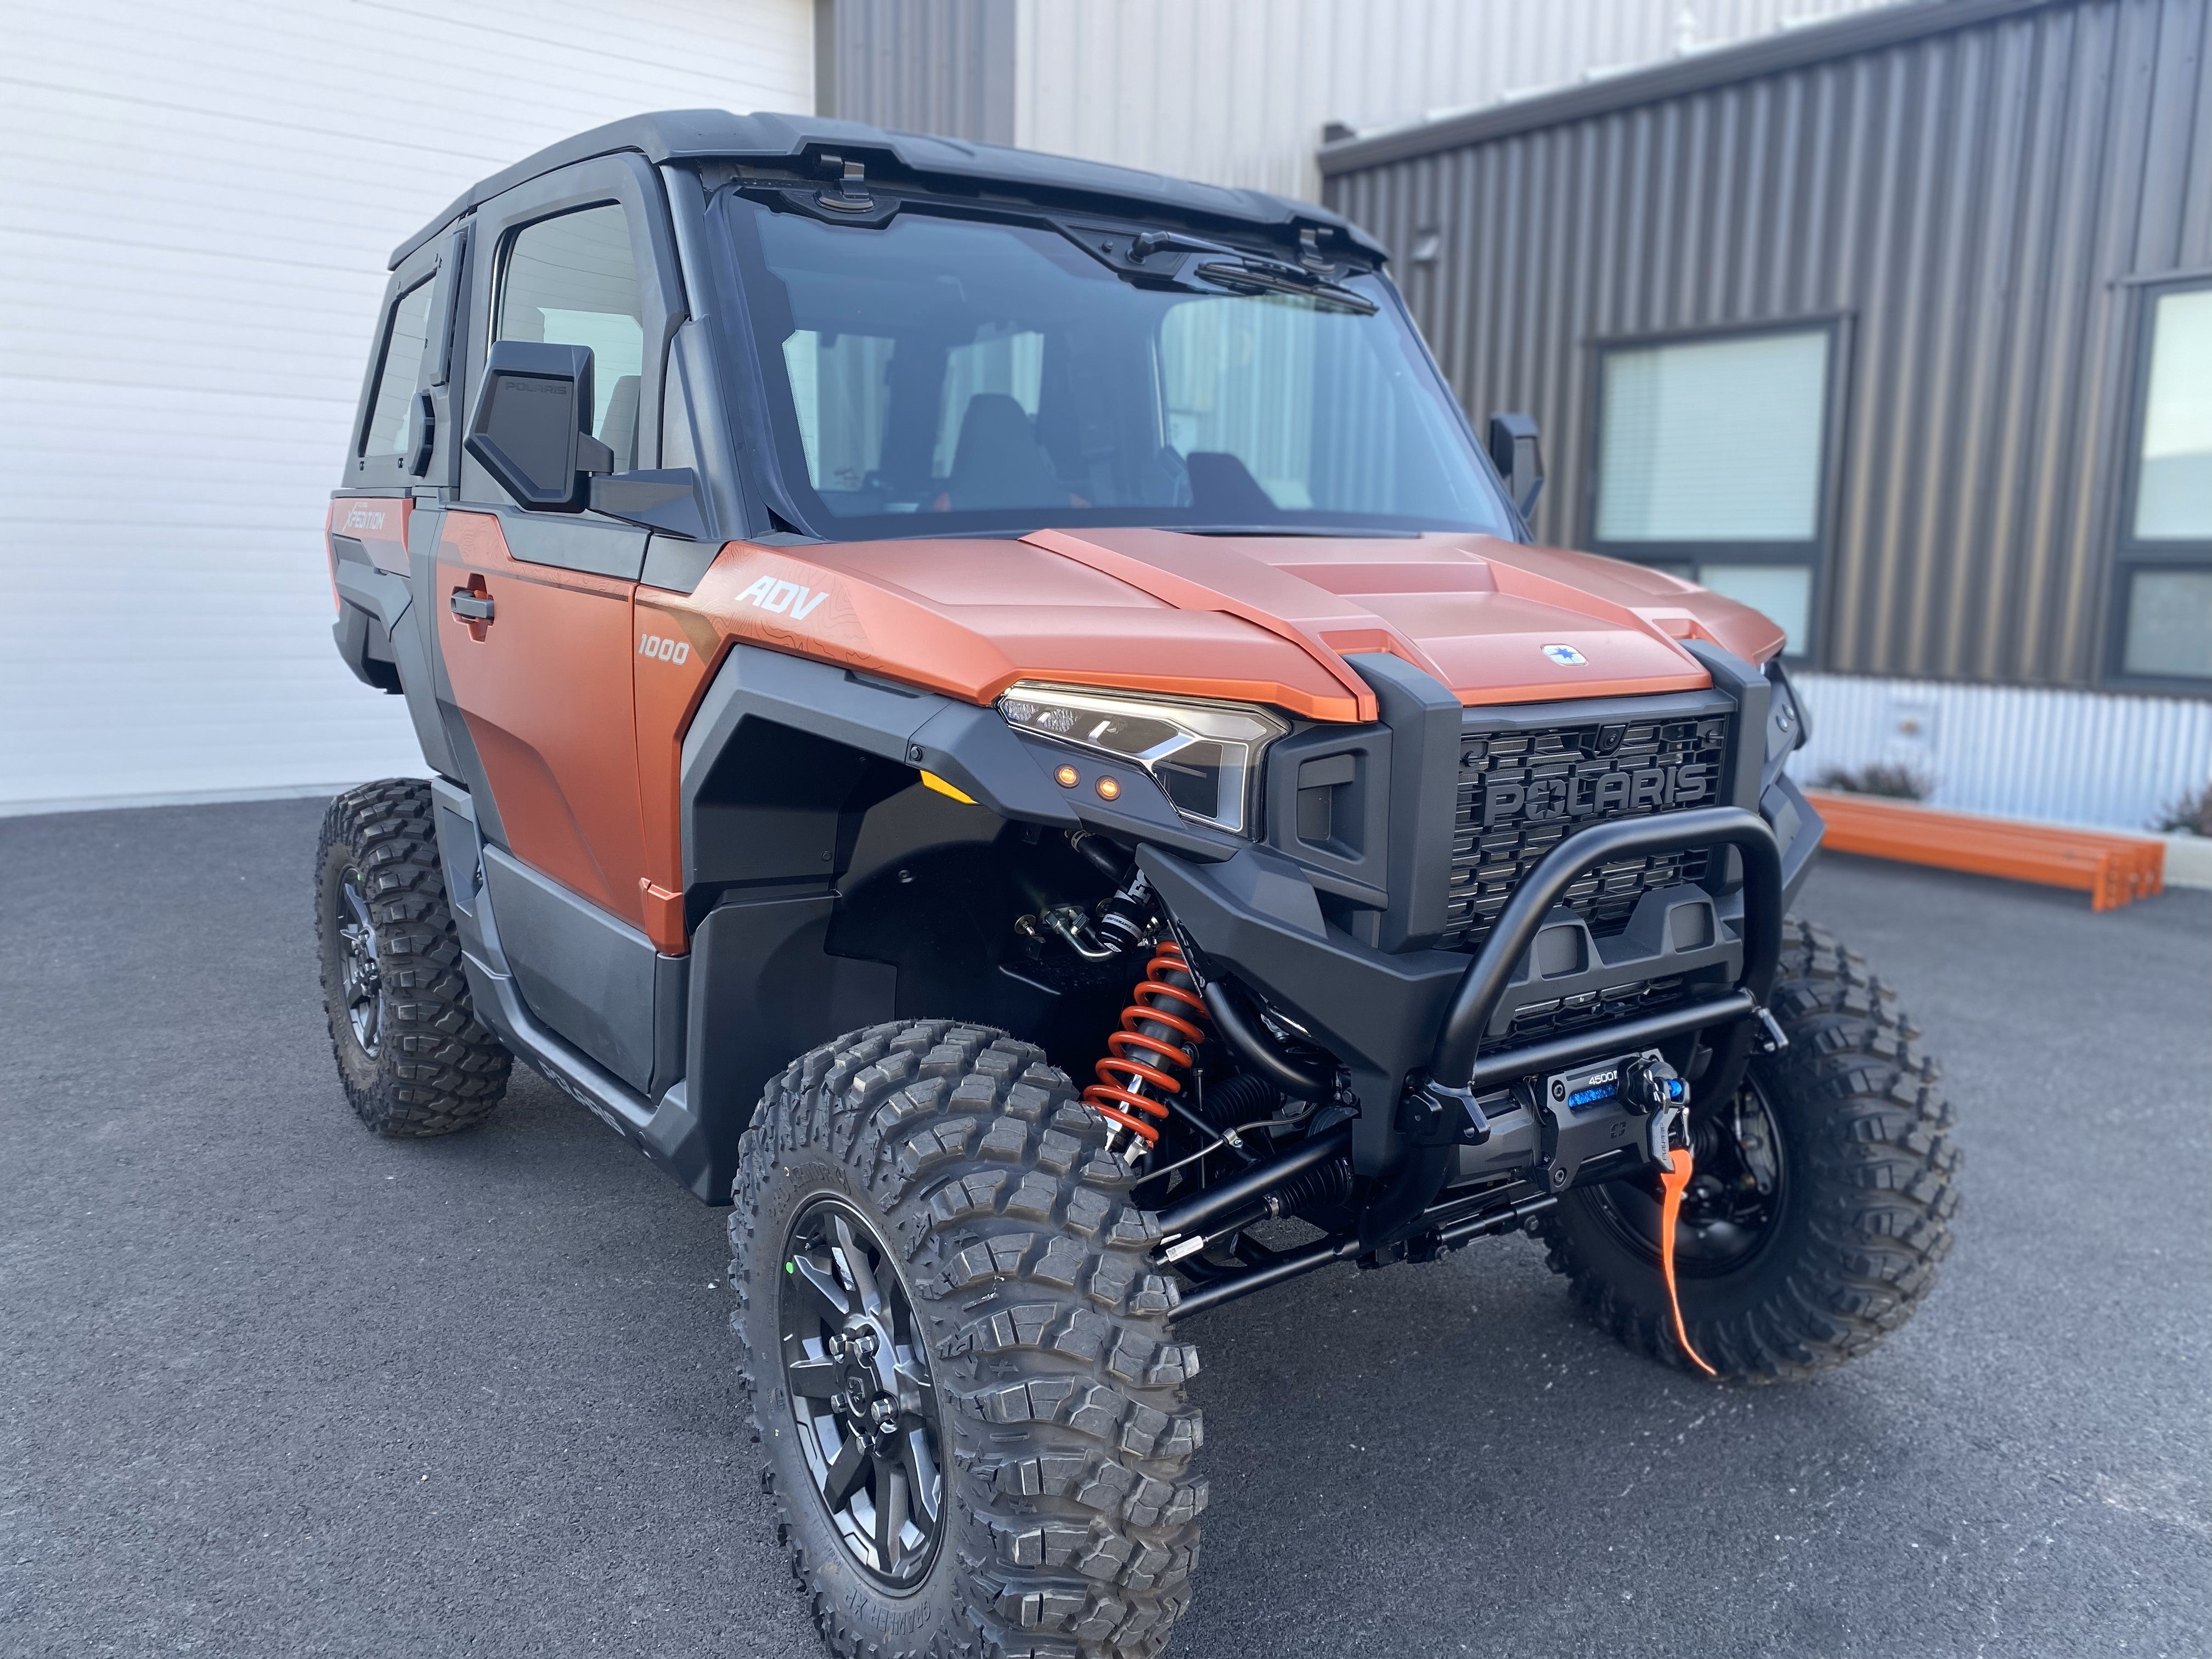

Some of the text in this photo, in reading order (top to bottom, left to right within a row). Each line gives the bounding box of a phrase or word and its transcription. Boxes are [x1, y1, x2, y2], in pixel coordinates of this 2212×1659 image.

[505, 382, 567, 394] POLARIS
[734, 575, 829, 620] ADV
[639, 633, 690, 665] 1000
[1484, 763, 1707, 827] POLARIS
[537, 1059, 625, 1137] POLARIS
